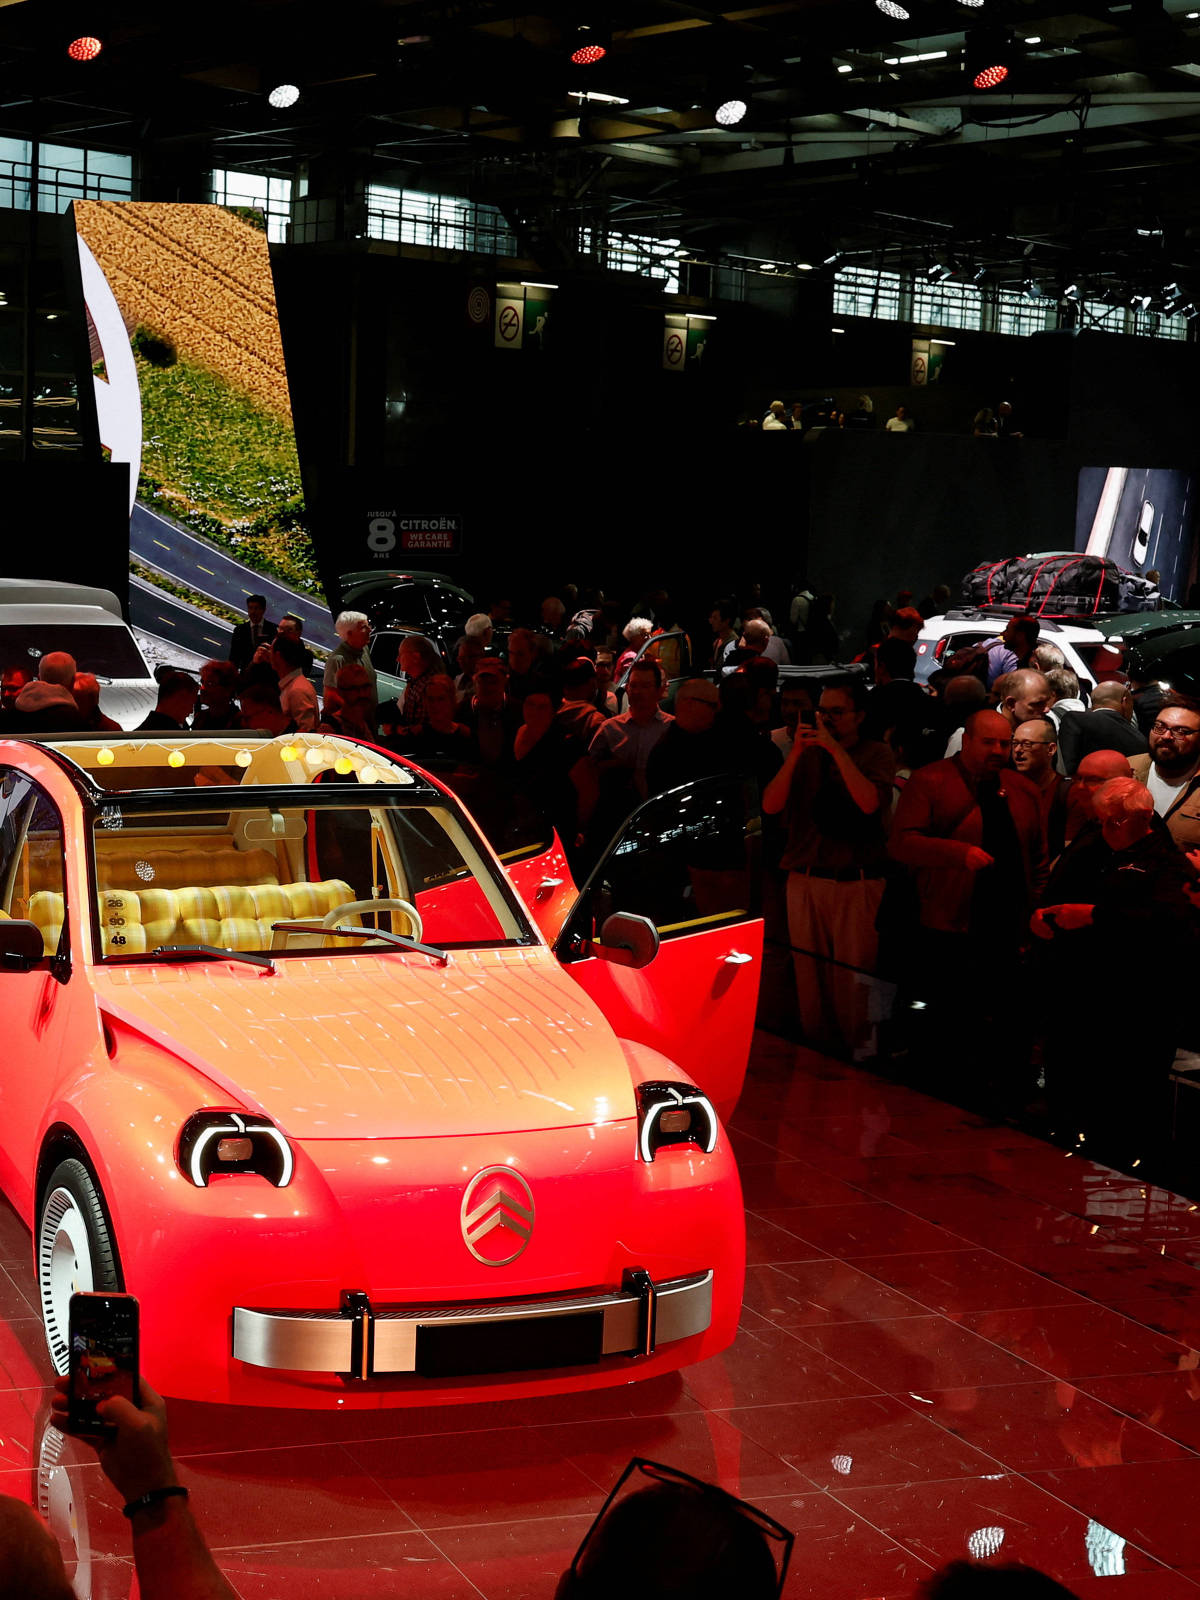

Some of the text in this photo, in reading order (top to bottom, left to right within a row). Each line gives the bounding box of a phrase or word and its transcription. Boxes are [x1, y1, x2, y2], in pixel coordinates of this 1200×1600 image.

[399, 516, 456, 530] CITROËN
[366, 517, 397, 553] 8
[425, 533, 449, 541] CARE
[407, 540, 452, 549] GARANTIE
[111, 935, 127, 945] 48
